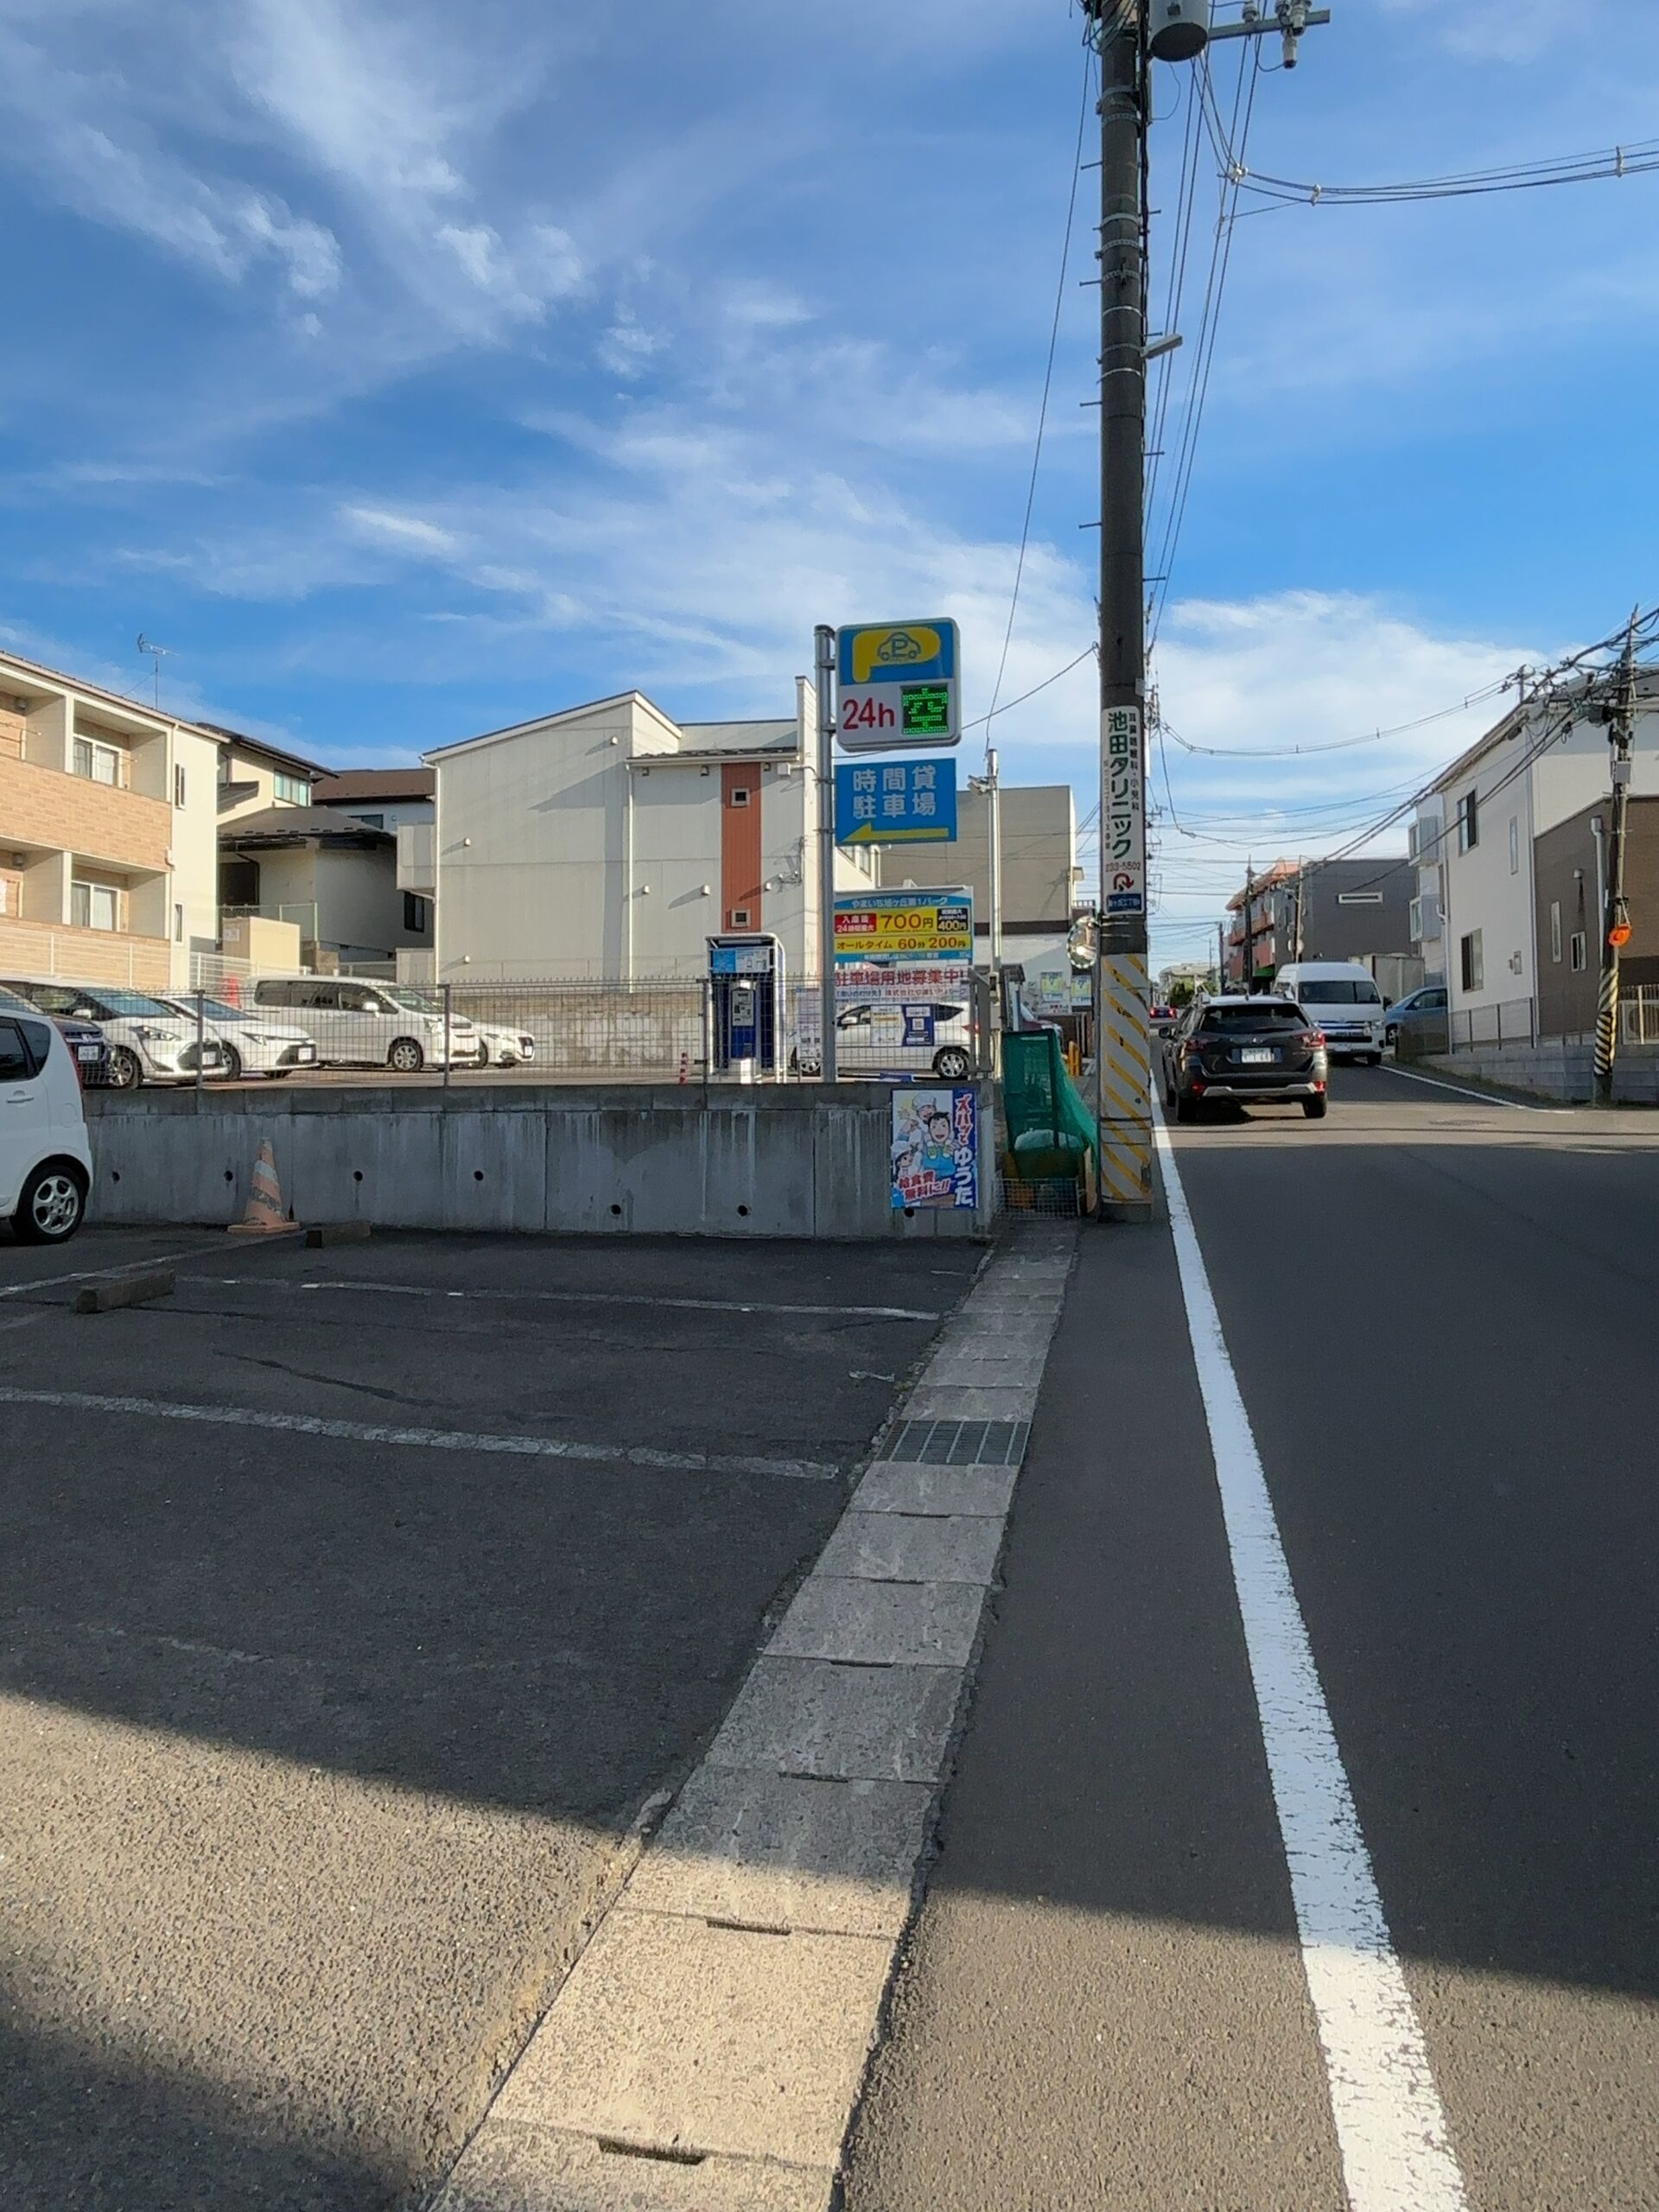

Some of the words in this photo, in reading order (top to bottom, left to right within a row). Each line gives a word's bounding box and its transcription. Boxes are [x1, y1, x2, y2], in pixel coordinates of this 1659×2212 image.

[842, 696, 895, 730] 24h
[902, 688, 949, 734] 空
[853, 765, 937, 793] 時間貸
[1108, 712, 1131, 860] 池田クリニック
[853, 792, 937, 820] 駐車場
[1105, 861, 1141, 874] 233-5502
[880, 913, 934, 931] 700円
[938, 919, 967, 931] 400円
[836, 940, 893, 950] オールタイム
[898, 938, 926, 950] 60分
[929, 937, 967, 949] 200円
